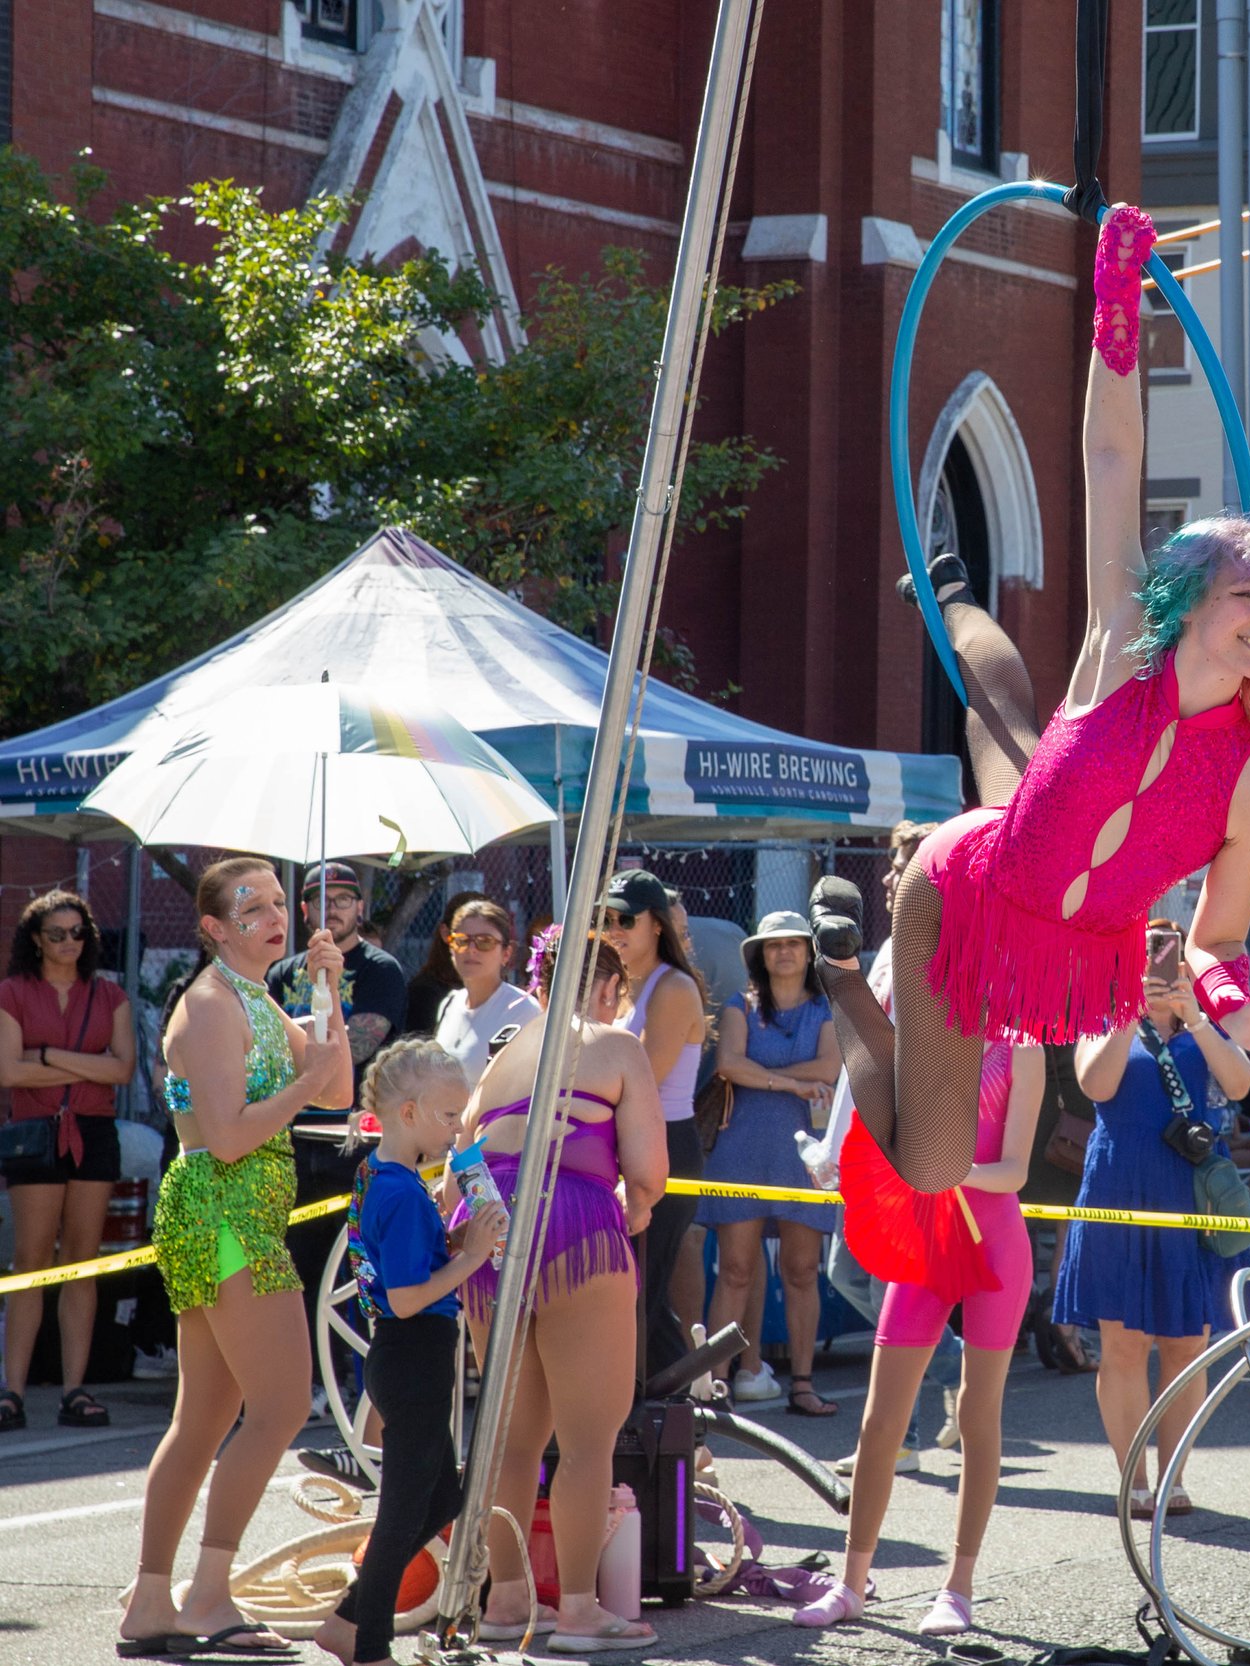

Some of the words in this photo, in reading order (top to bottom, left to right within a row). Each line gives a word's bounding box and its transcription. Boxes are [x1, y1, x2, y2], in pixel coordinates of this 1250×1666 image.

[699, 751, 772, 779] HI-WIRE
[778, 754, 858, 788] BREWING
[772, 786, 806, 799] NORTH
